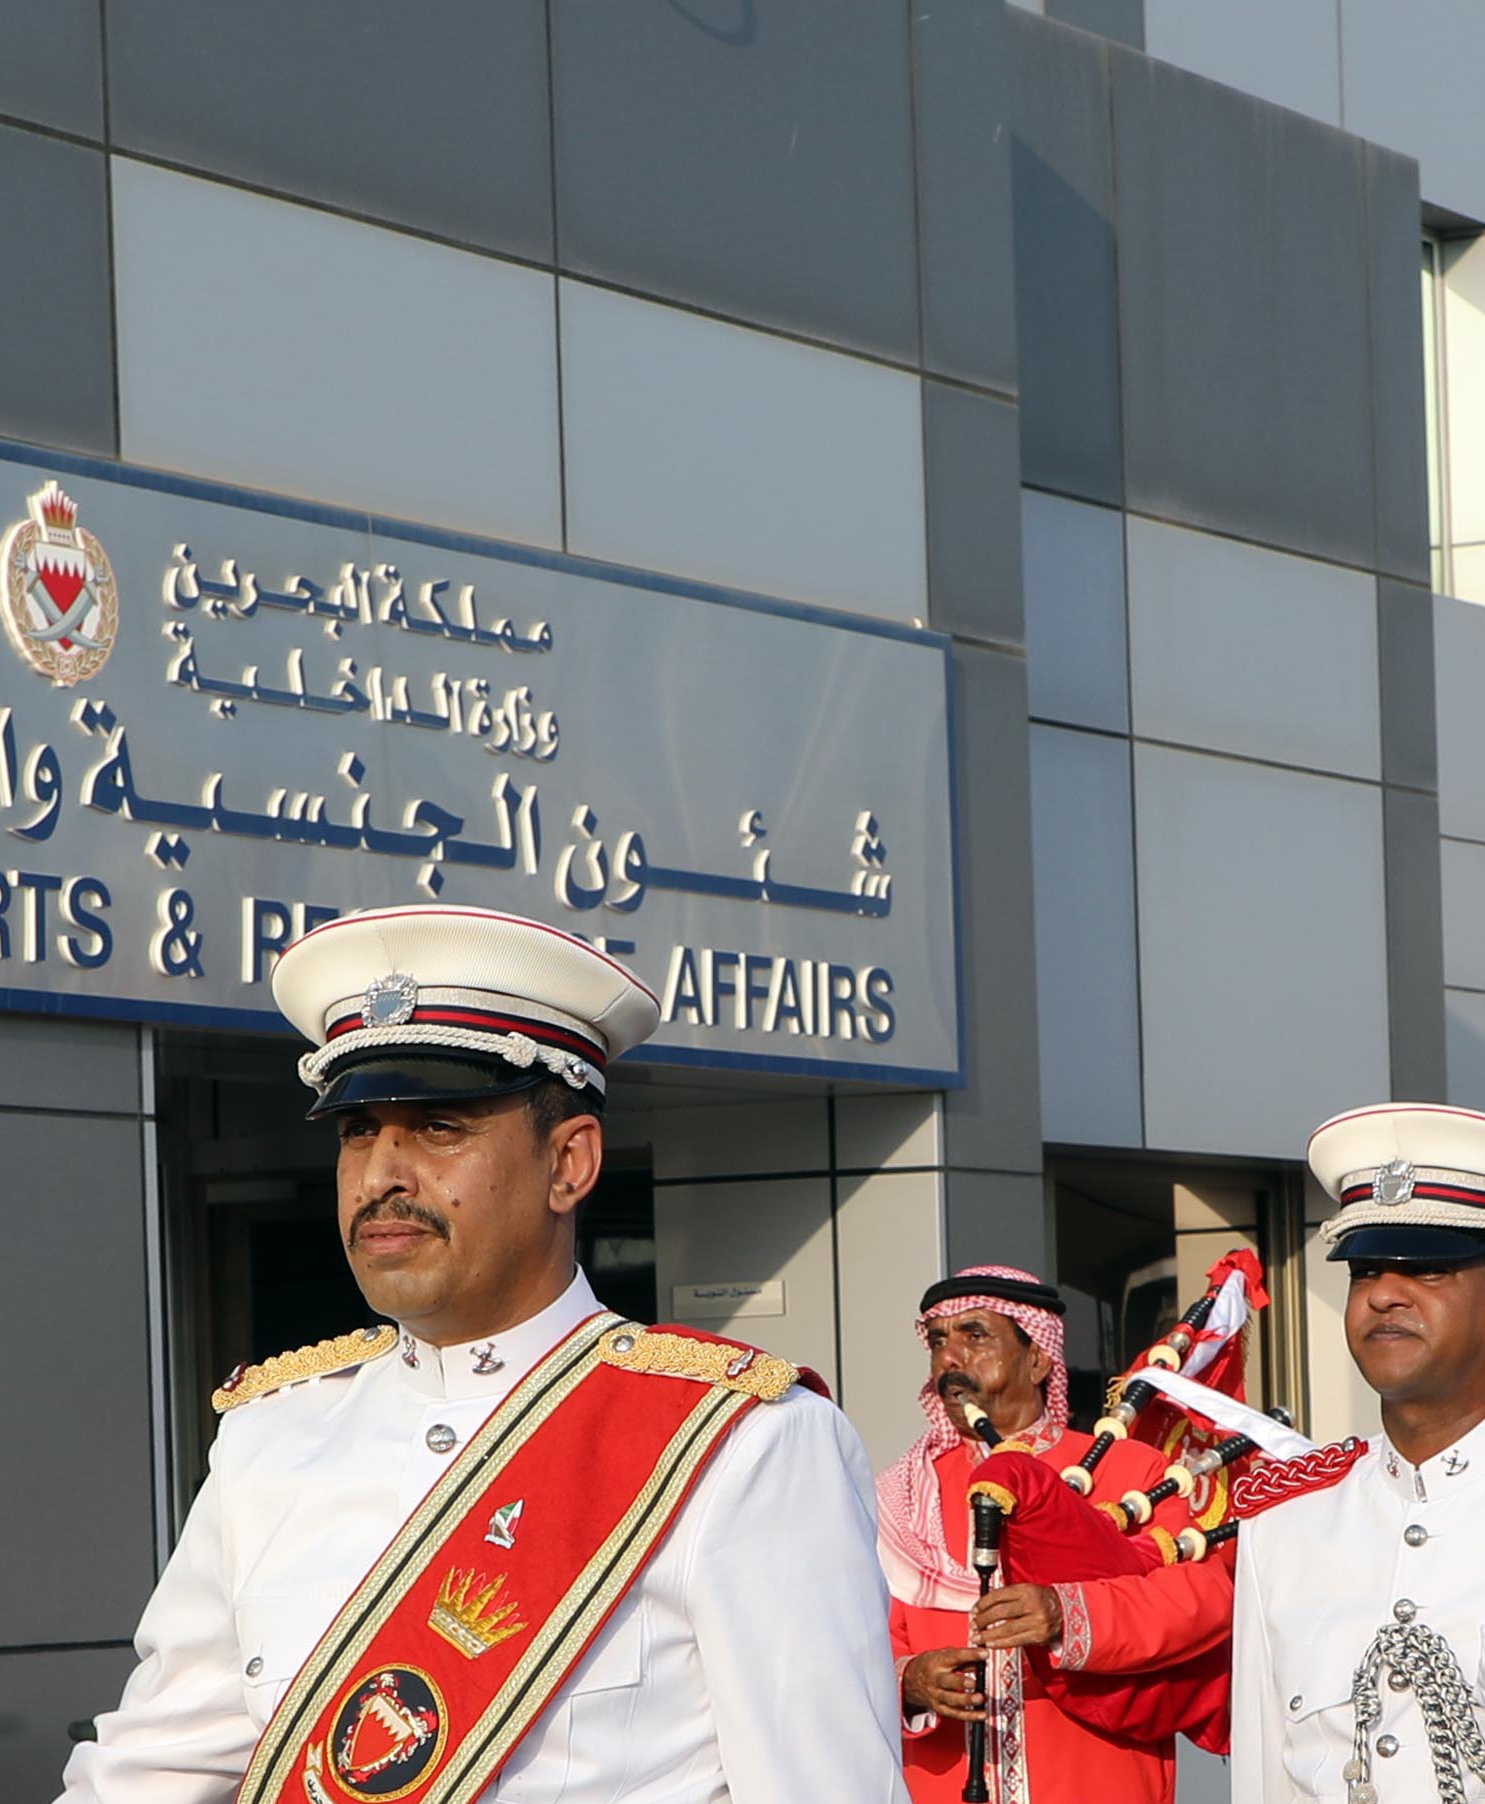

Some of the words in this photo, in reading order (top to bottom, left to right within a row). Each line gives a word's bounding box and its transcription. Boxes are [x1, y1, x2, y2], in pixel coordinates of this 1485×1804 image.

[161, 541, 373, 641] البحرين
[377, 562, 554, 653] مملكة
[161, 620, 464, 735] الداخلية
[465, 676, 560, 763] وزارة
[76, 696, 540, 898] الجنسية
[150, 886, 205, 981] &
[662, 944, 896, 1045] AFFAIRS
